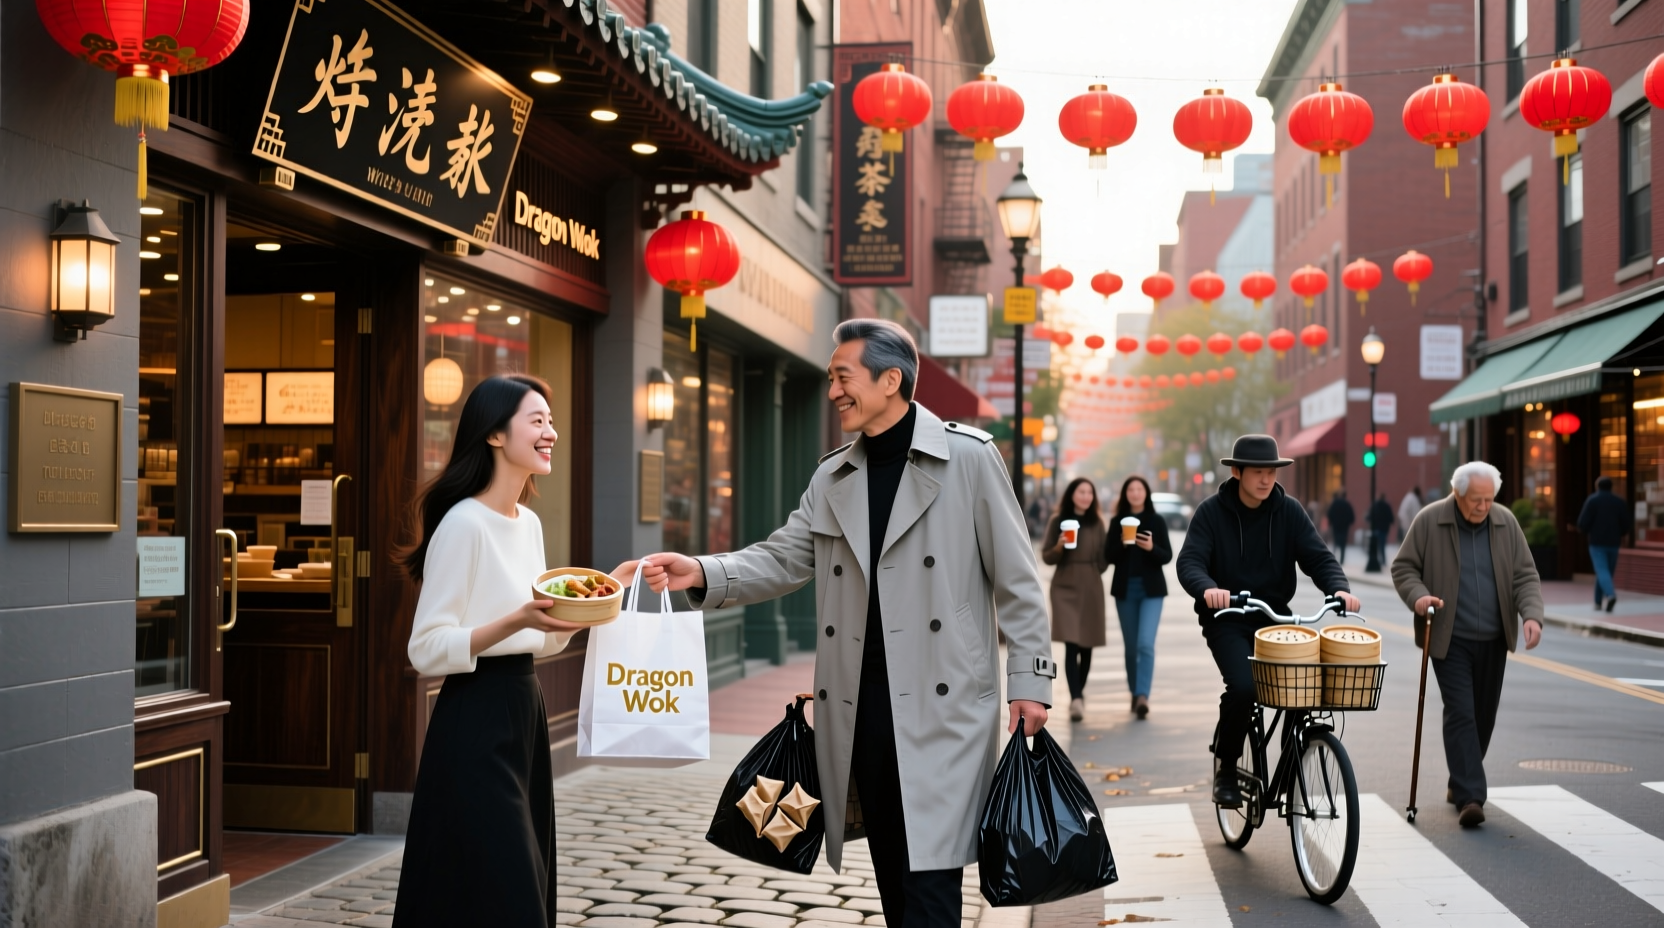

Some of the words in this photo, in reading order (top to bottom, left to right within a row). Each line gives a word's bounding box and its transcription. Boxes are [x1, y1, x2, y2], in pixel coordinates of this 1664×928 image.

[514, 190, 568, 246] Dragon
[568, 218, 600, 260] Wok
[607, 662, 694, 693] Dragon
[622, 689, 680, 714] Wok
